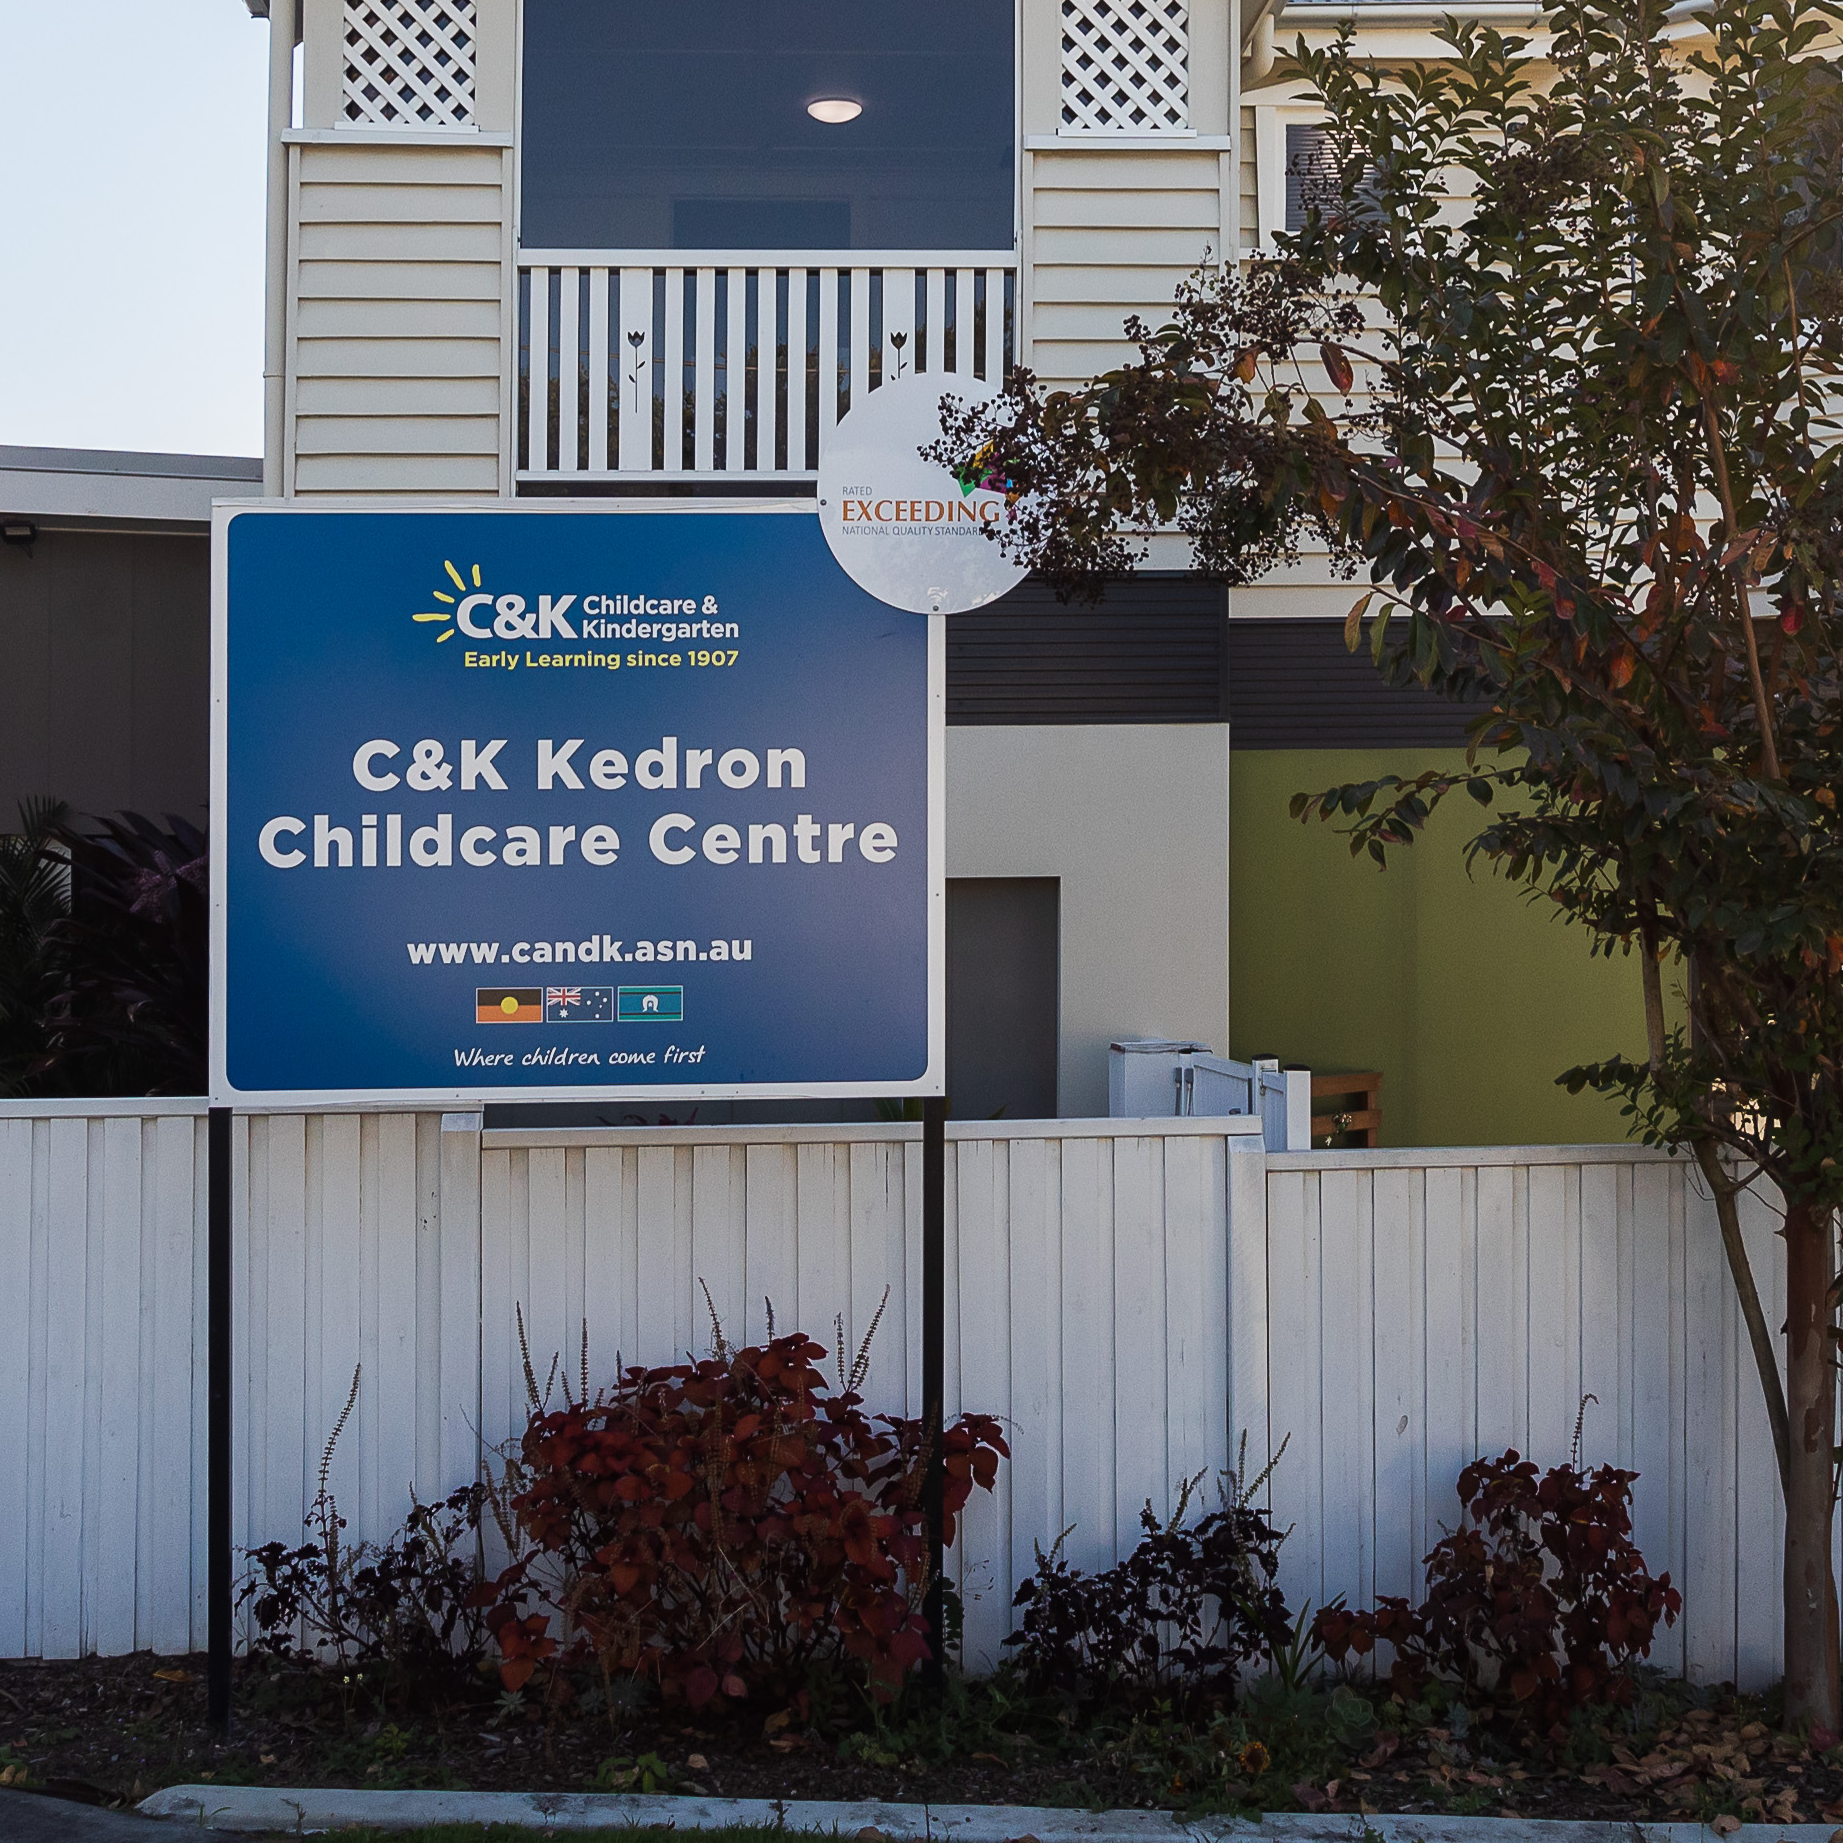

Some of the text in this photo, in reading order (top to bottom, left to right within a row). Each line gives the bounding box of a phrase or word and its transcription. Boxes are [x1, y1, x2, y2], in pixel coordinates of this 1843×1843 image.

[842, 486, 872, 496] RATED
[842, 500, 1000, 522] EXCEEDING
[842, 526, 890, 535] NATIONAL
[893, 526, 933, 536] QUALITY
[456, 593, 718, 641] C&K Childcare &
[582, 618, 739, 643] Kindergarten
[464, 650, 739, 671] Early Learning since 1907
[352, 737, 807, 792] C&K Kedron
[258, 813, 899, 869] Childcare Centre
[407, 935, 753, 966] www.candk.asn.au
[454, 1045, 706, 1067] Where children come first
